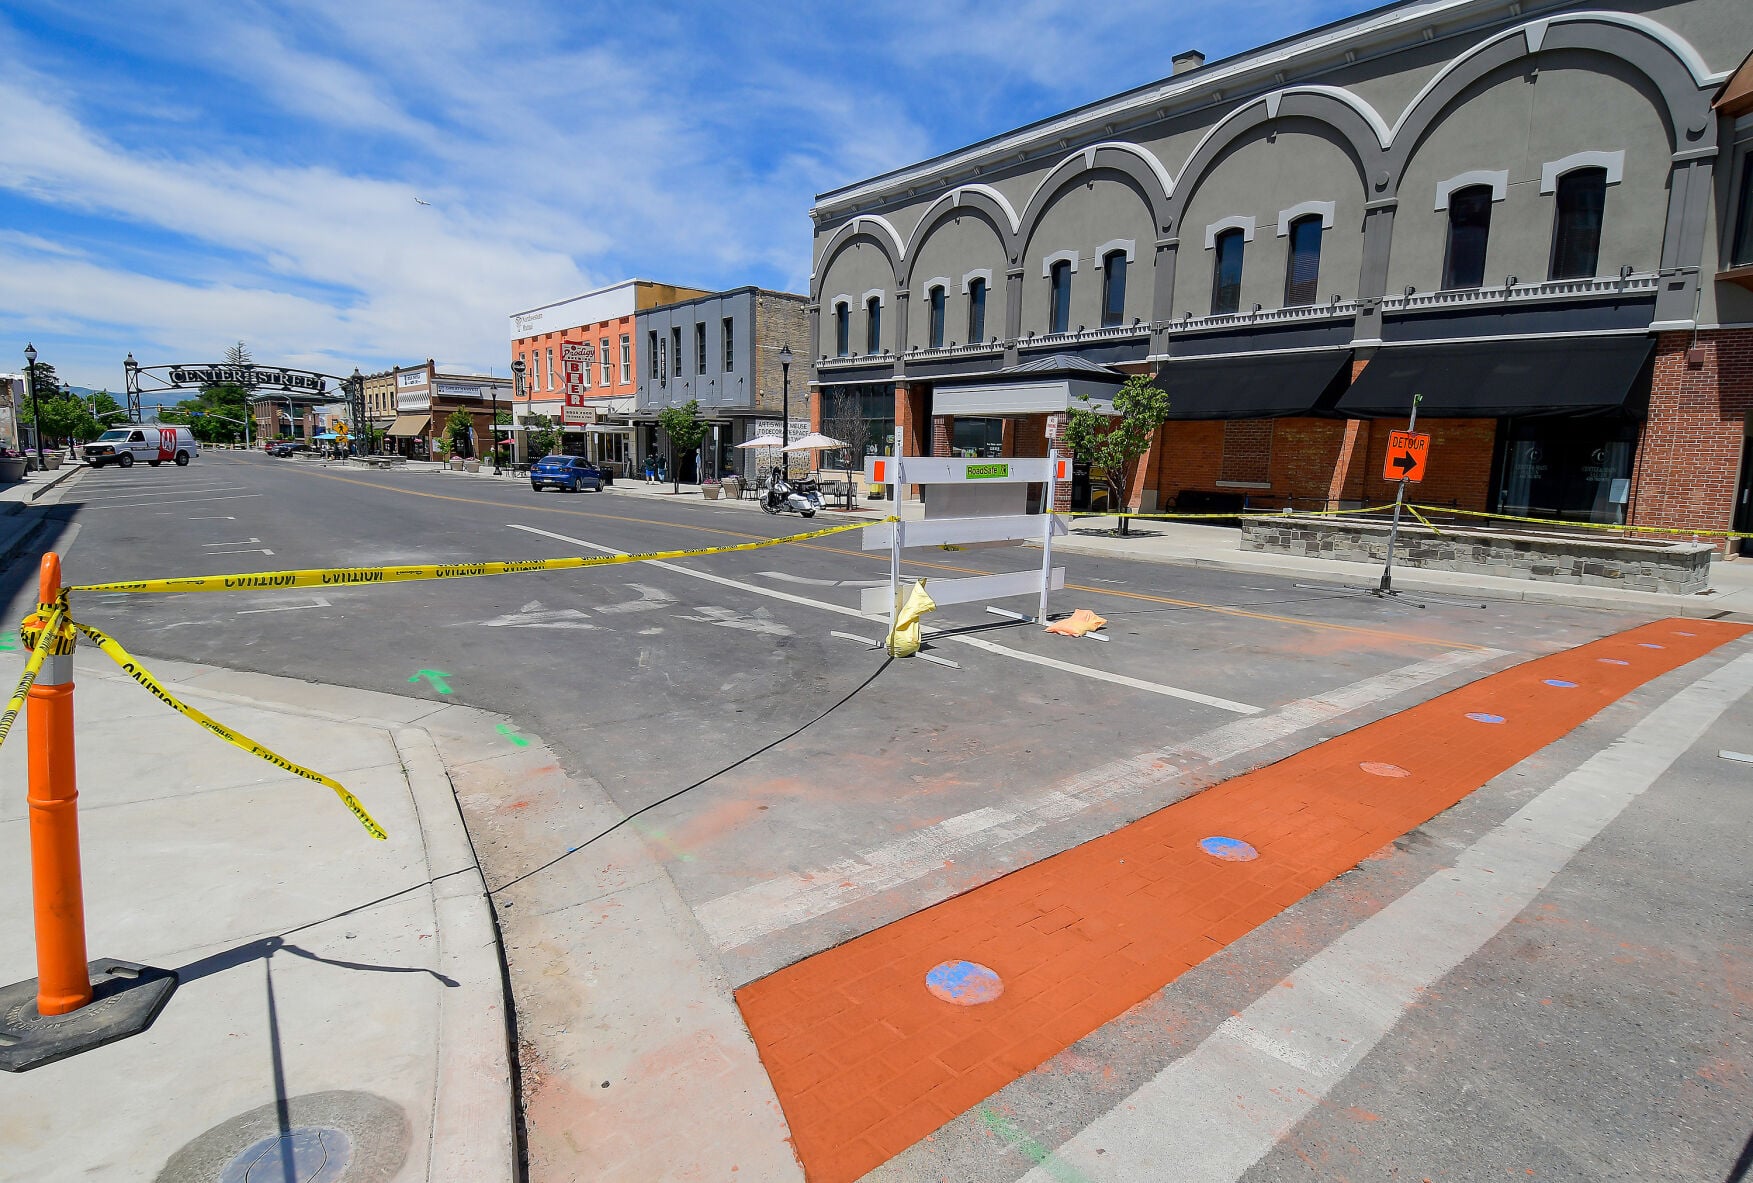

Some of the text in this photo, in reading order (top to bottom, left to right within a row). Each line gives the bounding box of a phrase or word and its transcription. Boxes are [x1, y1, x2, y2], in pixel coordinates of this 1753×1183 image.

[562, 348, 594, 359] Prodigy
[172, 370, 325, 390] CENTER STREET
[570, 362, 581, 405] BEER
[1392, 436, 1425, 450] DETOUR
[967, 465, 998, 476] RoadSafe
